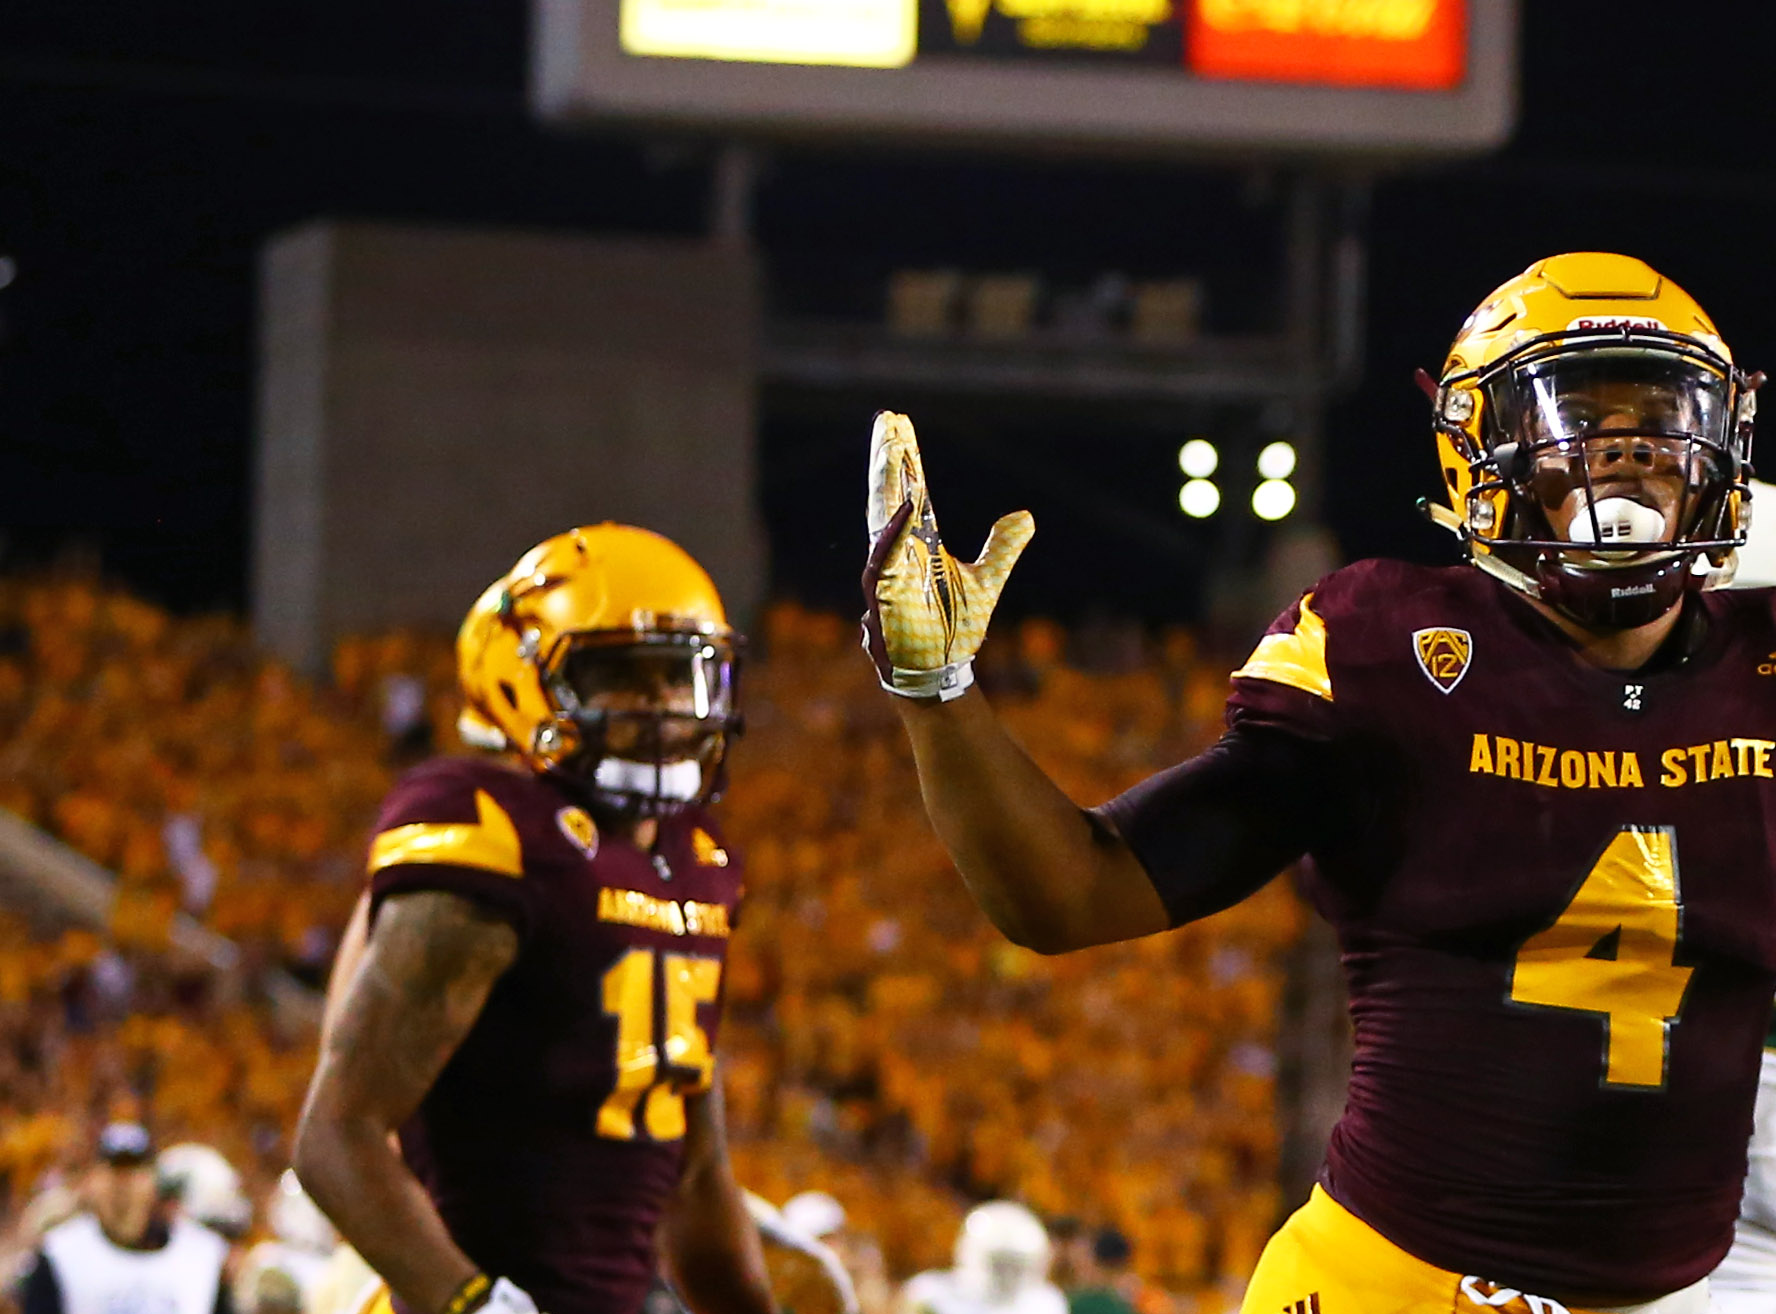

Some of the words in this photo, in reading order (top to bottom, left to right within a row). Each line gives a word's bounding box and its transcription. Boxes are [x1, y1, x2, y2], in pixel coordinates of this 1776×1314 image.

[1431, 653, 1459, 678] 12
[1469, 732, 1644, 789] ARIZONA
[1660, 738, 1776, 788] STATE
[1504, 823, 1698, 1094] 4
[595, 946, 723, 1142] 15
